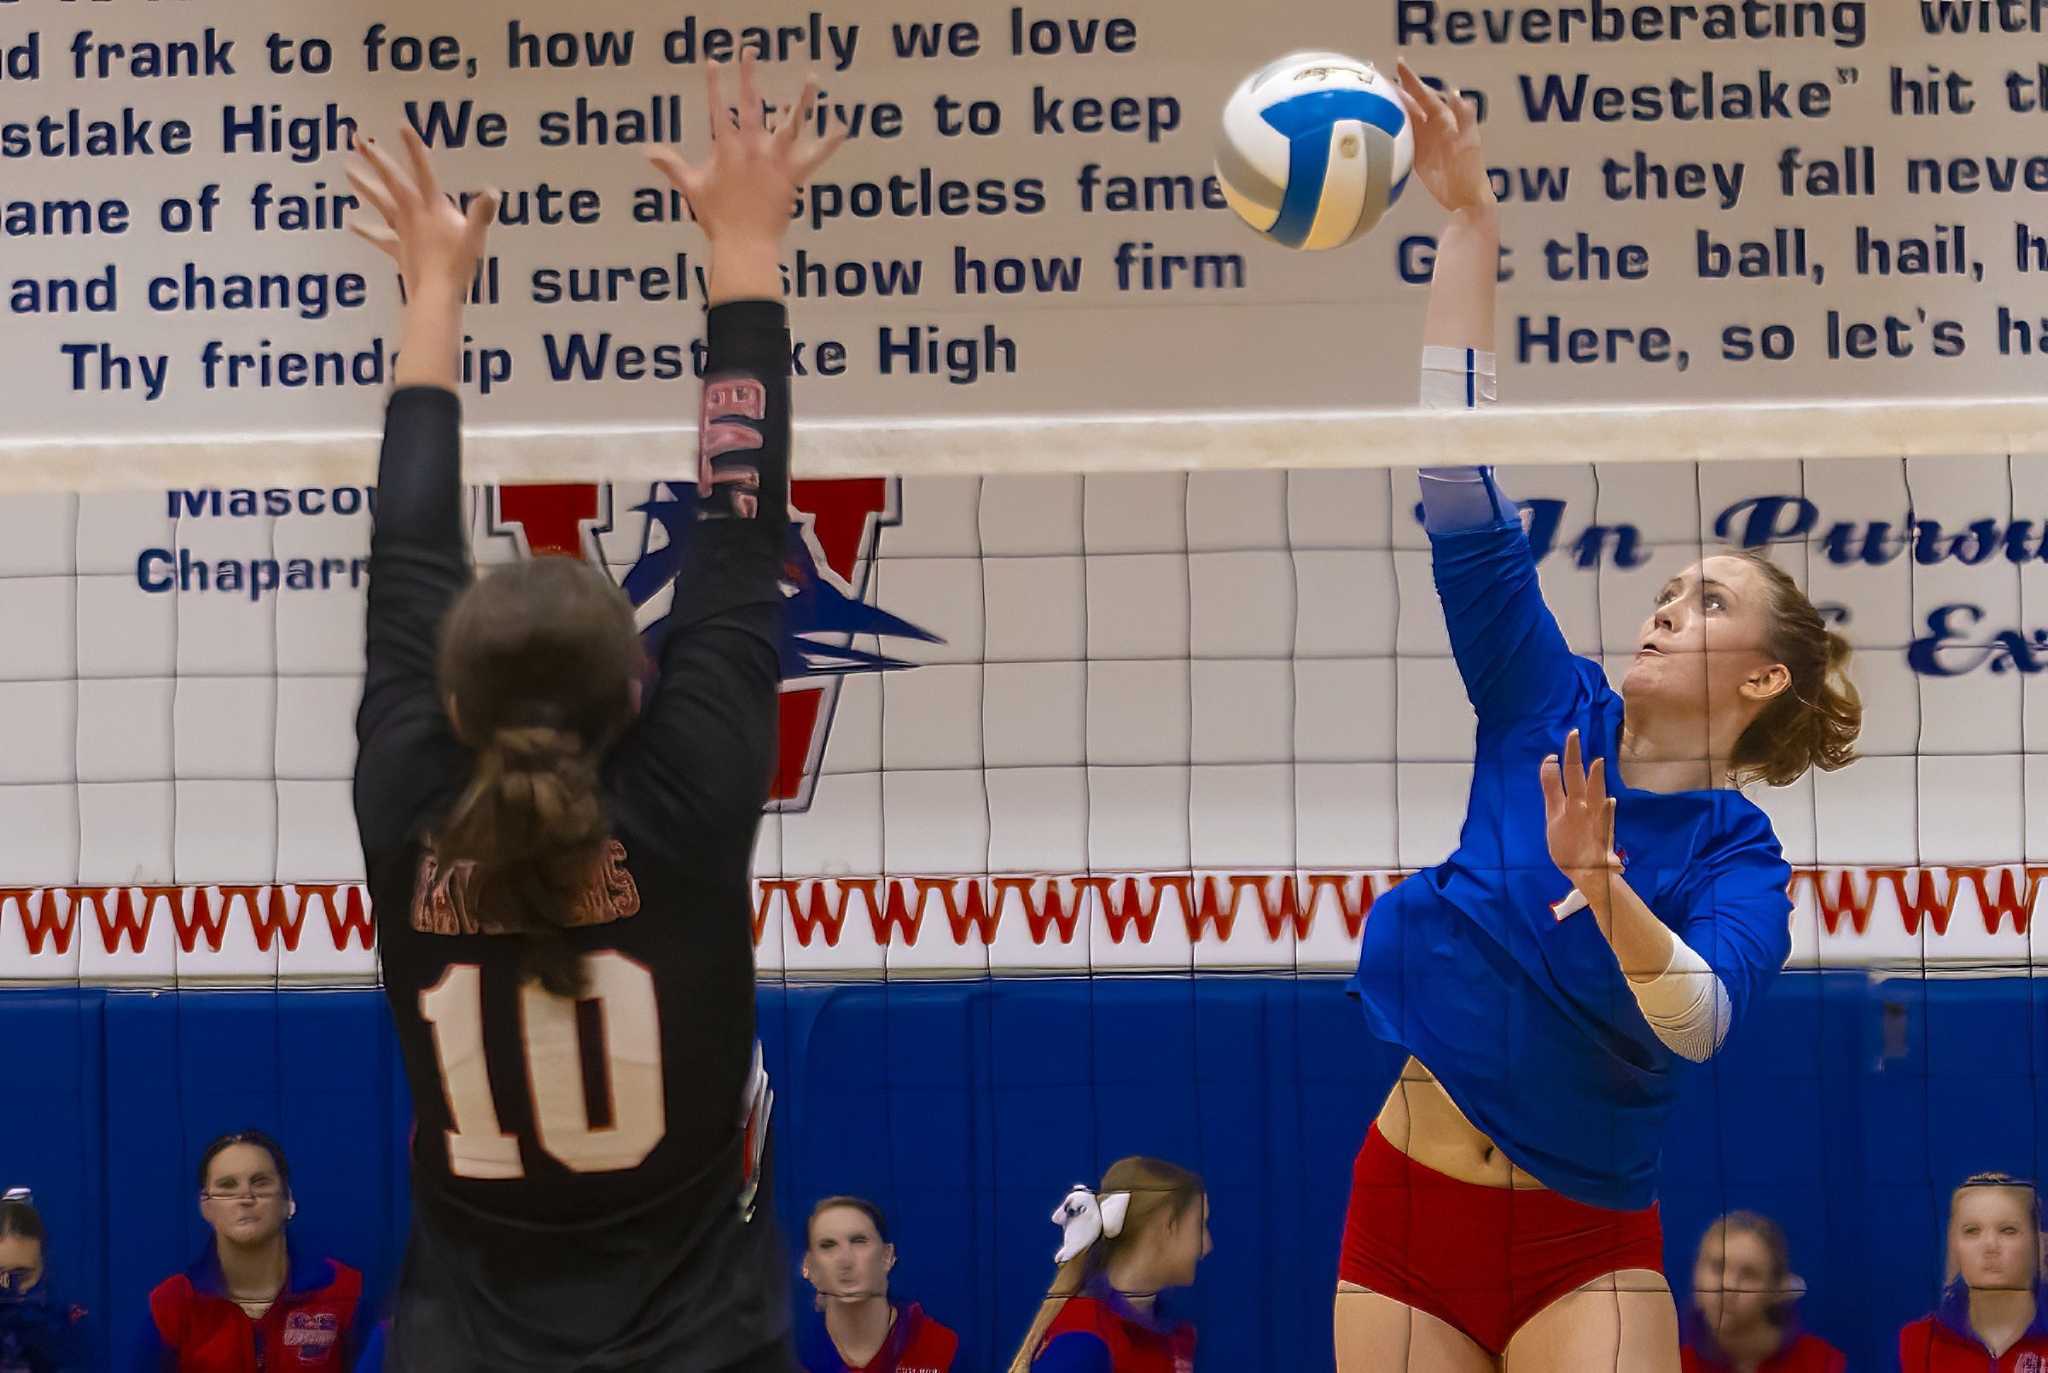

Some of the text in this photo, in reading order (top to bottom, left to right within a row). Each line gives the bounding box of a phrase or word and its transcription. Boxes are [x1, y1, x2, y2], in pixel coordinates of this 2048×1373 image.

[71, 28, 235, 79] frank
[266, 31, 332, 74] to
[364, 23, 478, 79] foe,
[508, 20, 634, 69] how
[664, 13, 859, 71] dearly
[892, 21, 980, 58] we
[1011, 7, 1137, 55] love
[1397, 0, 1866, 48] Reverberating
[404, 99, 507, 149] We
[540, 95, 681, 147] shall
[934, 93, 1001, 137] to
[1033, 86, 1181, 143] keep
[1890, 65, 1975, 115] hit
[0, 200, 129, 236] ame
[160, 183, 220, 233] of
[251, 182, 360, 236] fair
[1077, 164, 1230, 212] fame
[1486, 167, 1570, 203] ow
[1602, 151, 1745, 210] they
[1778, 146, 1875, 197] fall
[10, 264, 117, 314] and
[148, 263, 366, 320] change
[954, 246, 1082, 294] how
[1113, 242, 1245, 291] firm
[1397, 235, 1514, 284] Gt
[1544, 232, 1649, 281] the
[1696, 228, 1824, 285] ball,
[1855, 224, 1984, 282] hail,
[60, 325, 1016, 401] Thy friendip Westke High
[1516, 315, 1690, 371] Here,
[1721, 324, 1795, 361] so
[1827, 308, 1966, 359] let's
[418, 948, 666, 1180] 10
